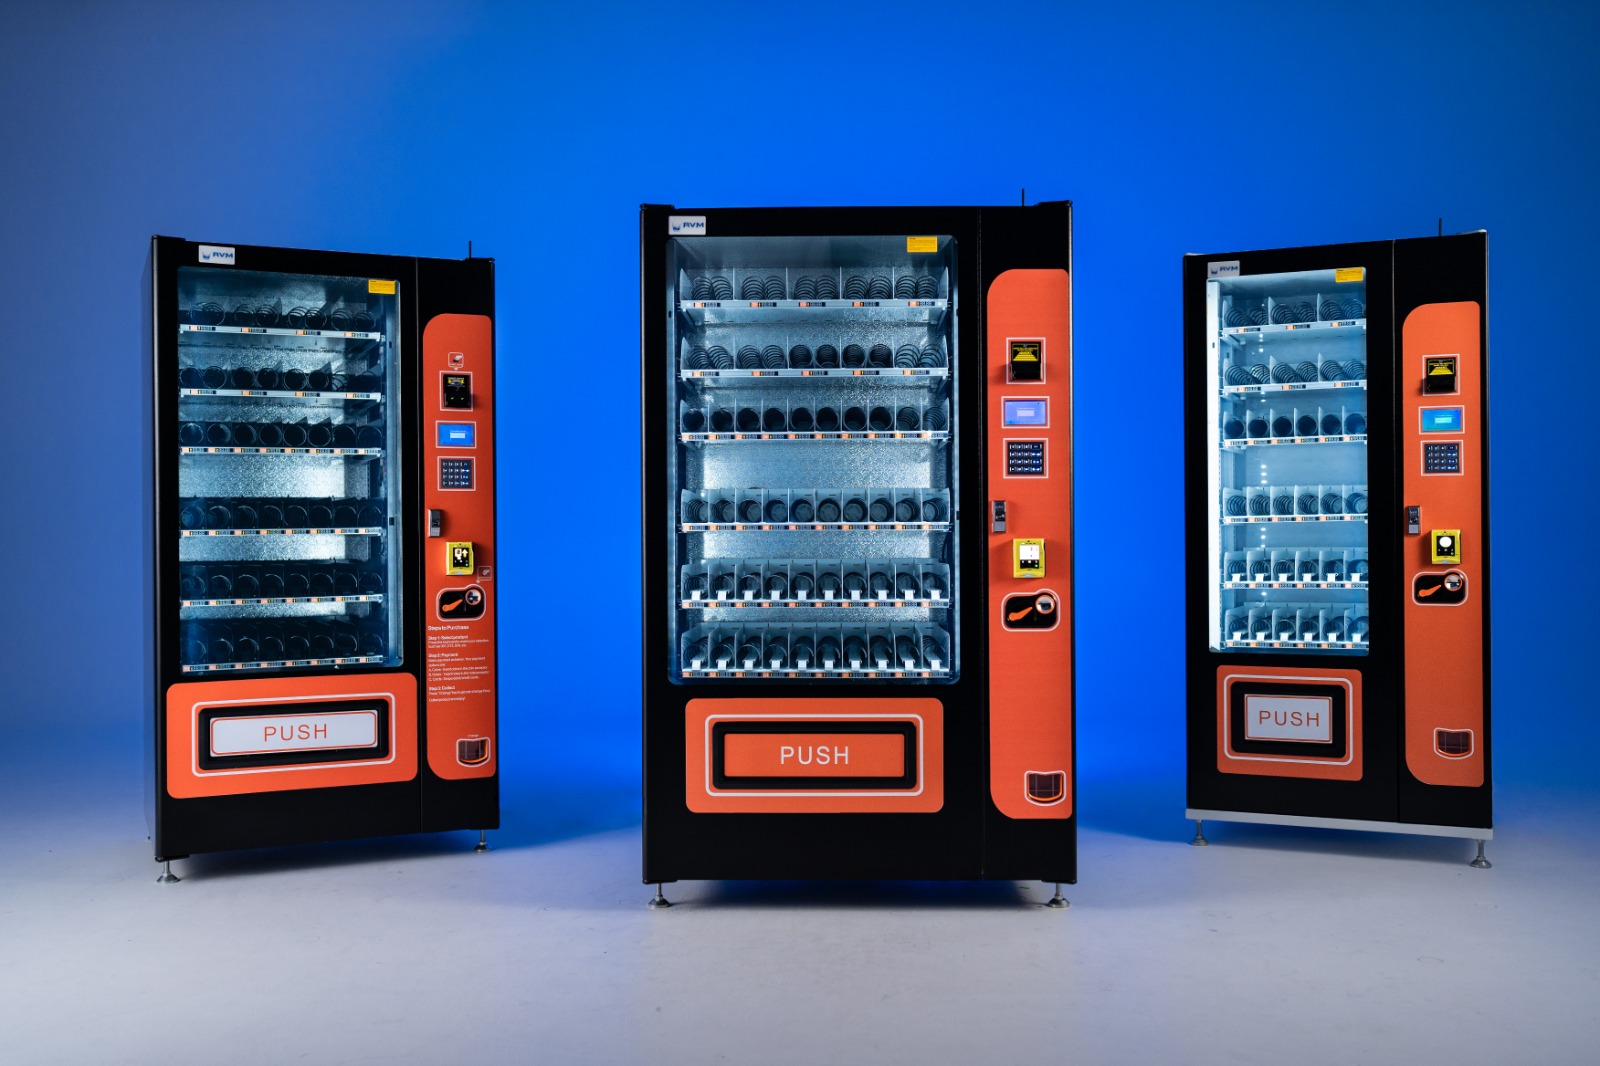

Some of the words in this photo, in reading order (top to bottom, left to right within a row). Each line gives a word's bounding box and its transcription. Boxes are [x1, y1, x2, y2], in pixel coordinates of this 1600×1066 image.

[1259, 711, 1319, 727] PUSH
[264, 724, 327, 742] PUSH
[781, 746, 849, 764] PUSH
